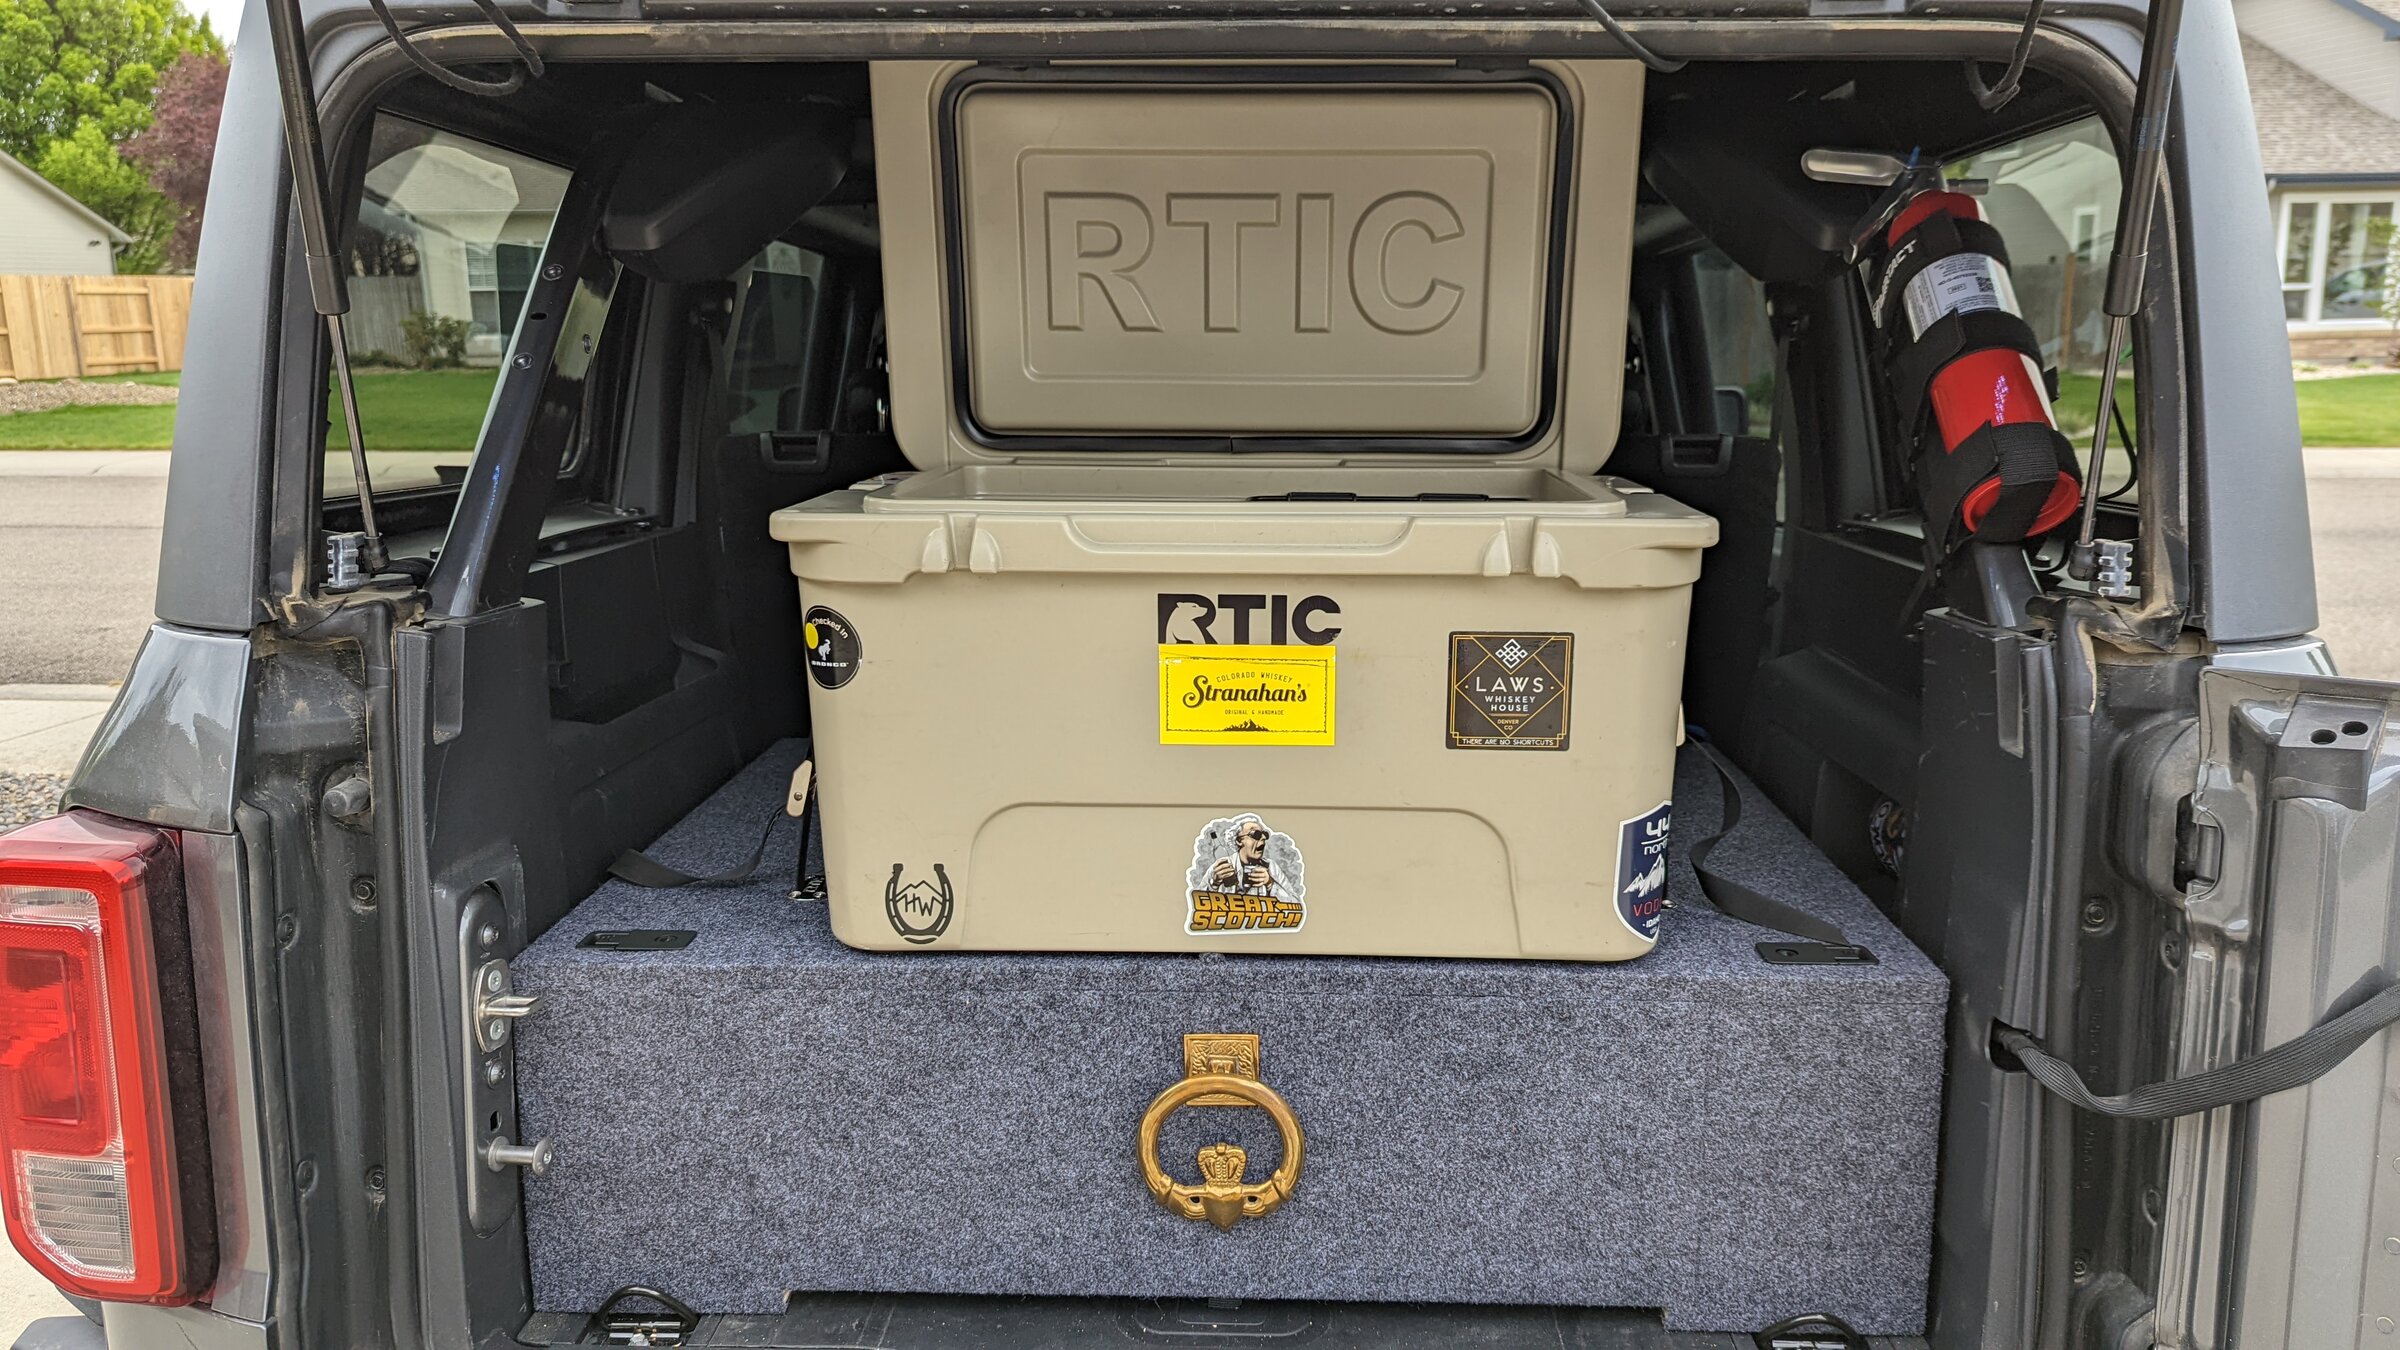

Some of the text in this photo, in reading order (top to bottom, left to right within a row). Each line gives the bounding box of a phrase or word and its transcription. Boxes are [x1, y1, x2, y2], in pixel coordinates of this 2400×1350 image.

[1043, 190, 1465, 336] RTIC
[1157, 593, 1342, 646] RTIC
[811, 660, 848, 668] BRONCO
[1216, 671, 1294, 684] COLORADO WHISKEY
[1475, 676, 1544, 693] LAWS
[1182, 674, 1308, 709] Stranahan's
[1484, 695, 1536, 704] WHISKEY
[1490, 704, 1529, 712] HOUSE
[1191, 890, 1279, 913] GREAT
[1633, 898, 1661, 917] VOD
[1189, 910, 1304, 931] SCOTCH!
